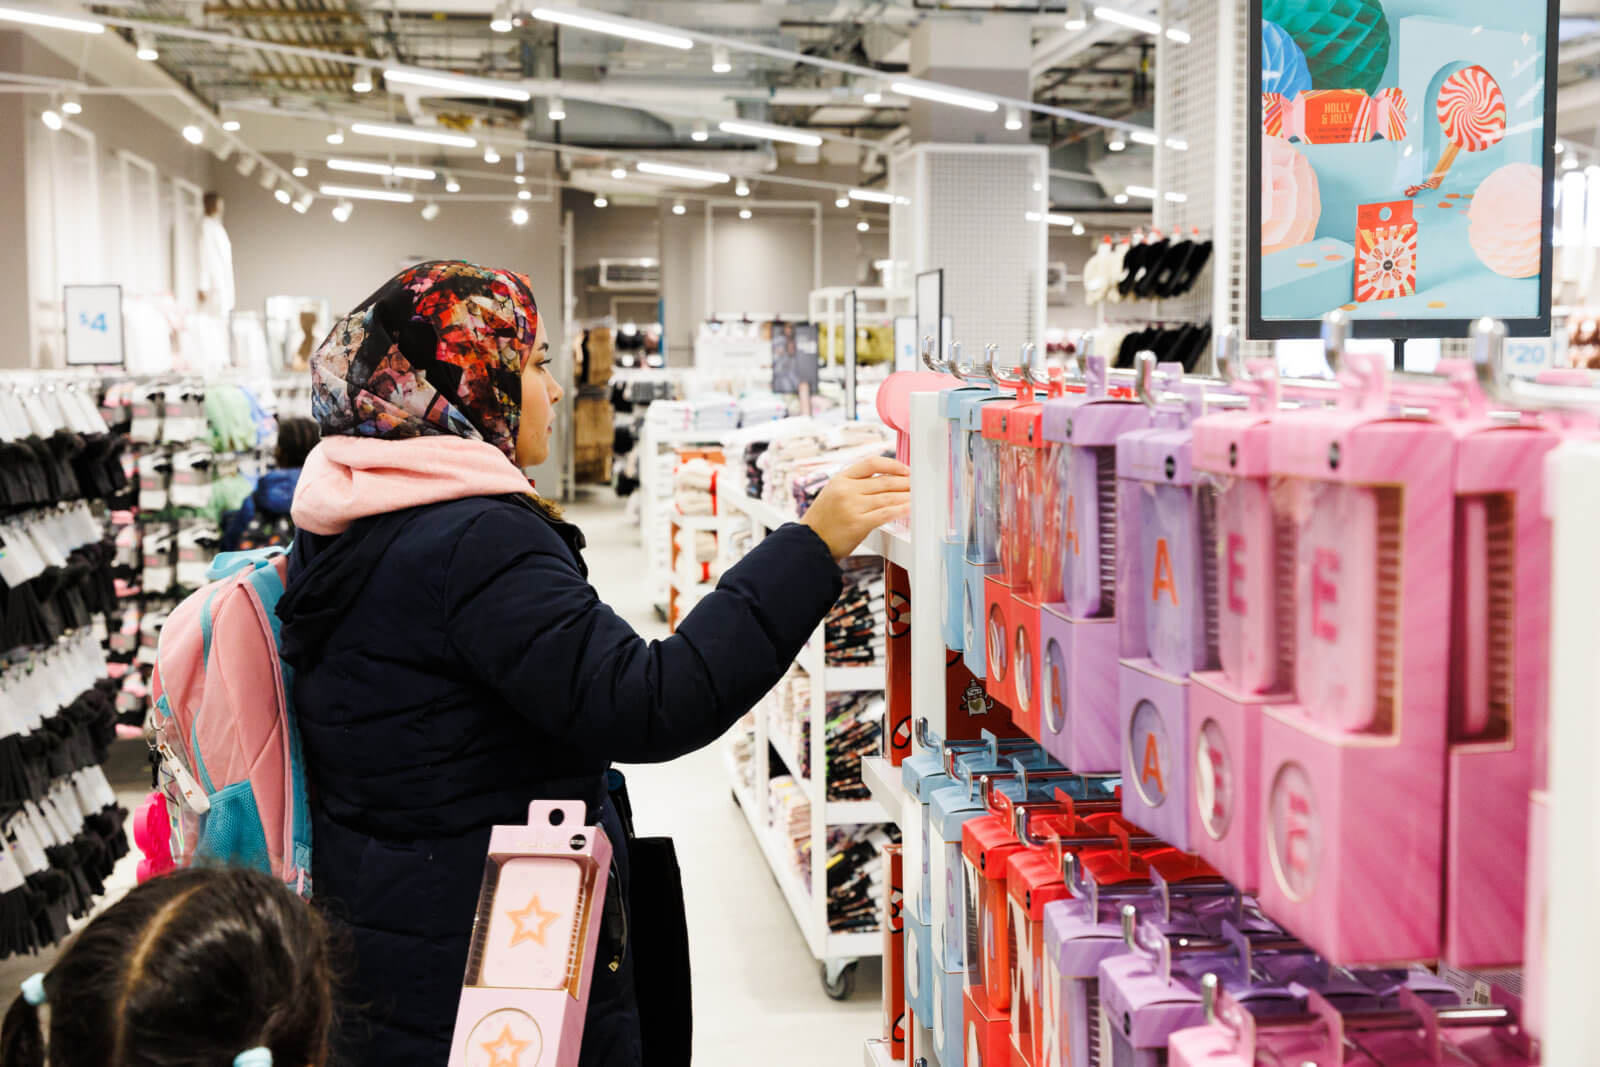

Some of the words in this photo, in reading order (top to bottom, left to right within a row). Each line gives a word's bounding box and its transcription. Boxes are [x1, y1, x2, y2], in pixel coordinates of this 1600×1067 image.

[1321, 113, 1329, 125] &
[1330, 113, 1353, 125] JOLLY
[1324, 102, 1351, 113] HOLLY
[80, 312, 107, 332] $4
[1152, 538, 1180, 607] A
[1226, 532, 1247, 616] E
[1312, 547, 1341, 643] E
[1052, 664, 1063, 717] A
[1142, 732, 1165, 794] A
